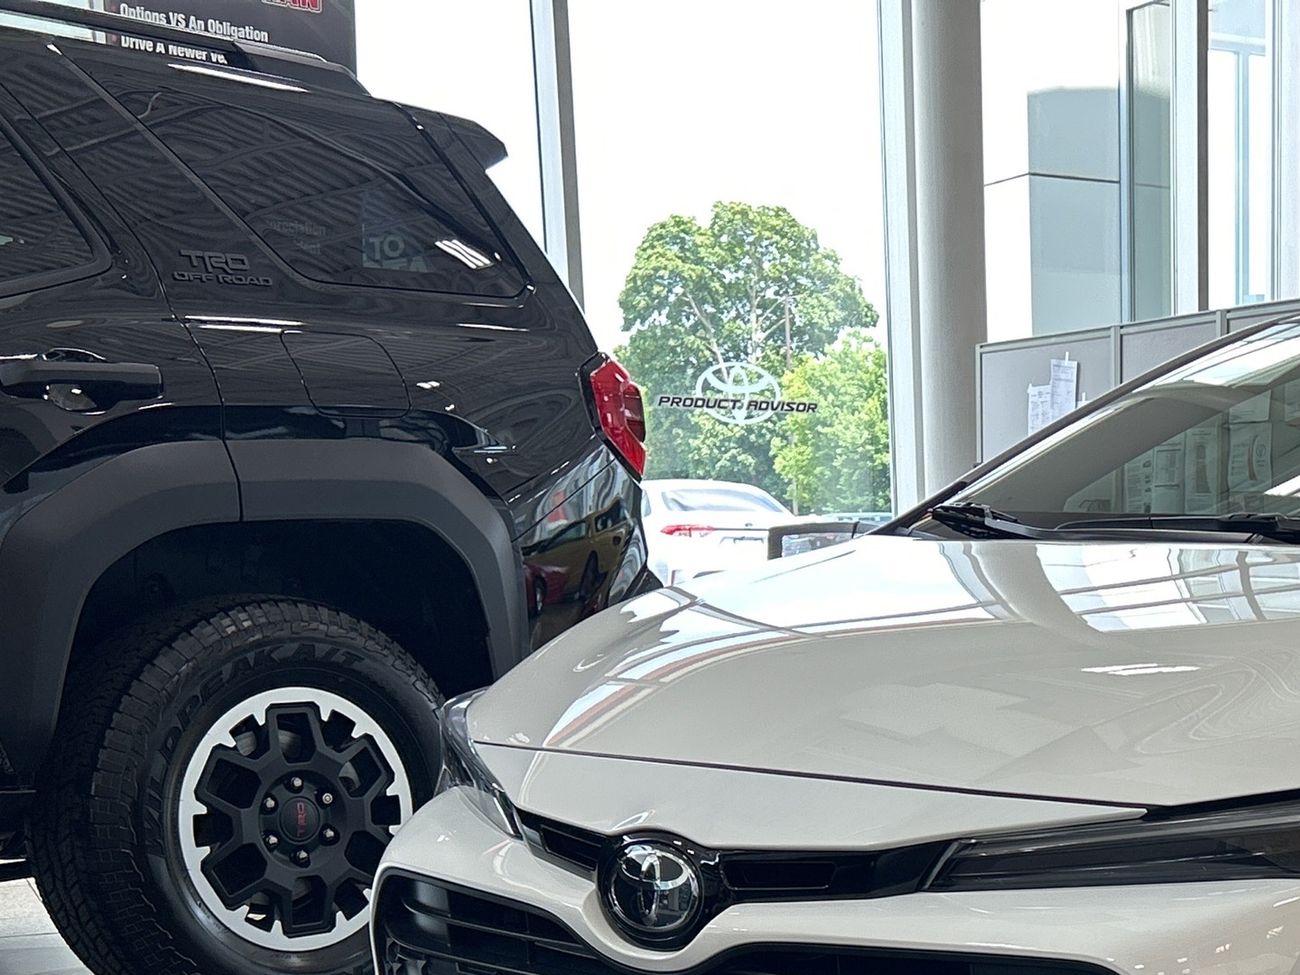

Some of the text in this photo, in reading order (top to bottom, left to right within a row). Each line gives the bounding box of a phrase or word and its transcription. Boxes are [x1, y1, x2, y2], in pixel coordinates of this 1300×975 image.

[120, 3, 268, 42] Options VS An Obligation
[180, 249, 250, 274] TRD
[173, 271, 273, 287] OFF ROAD
[658, 396, 818, 413] PRODUCT ADVISOR
